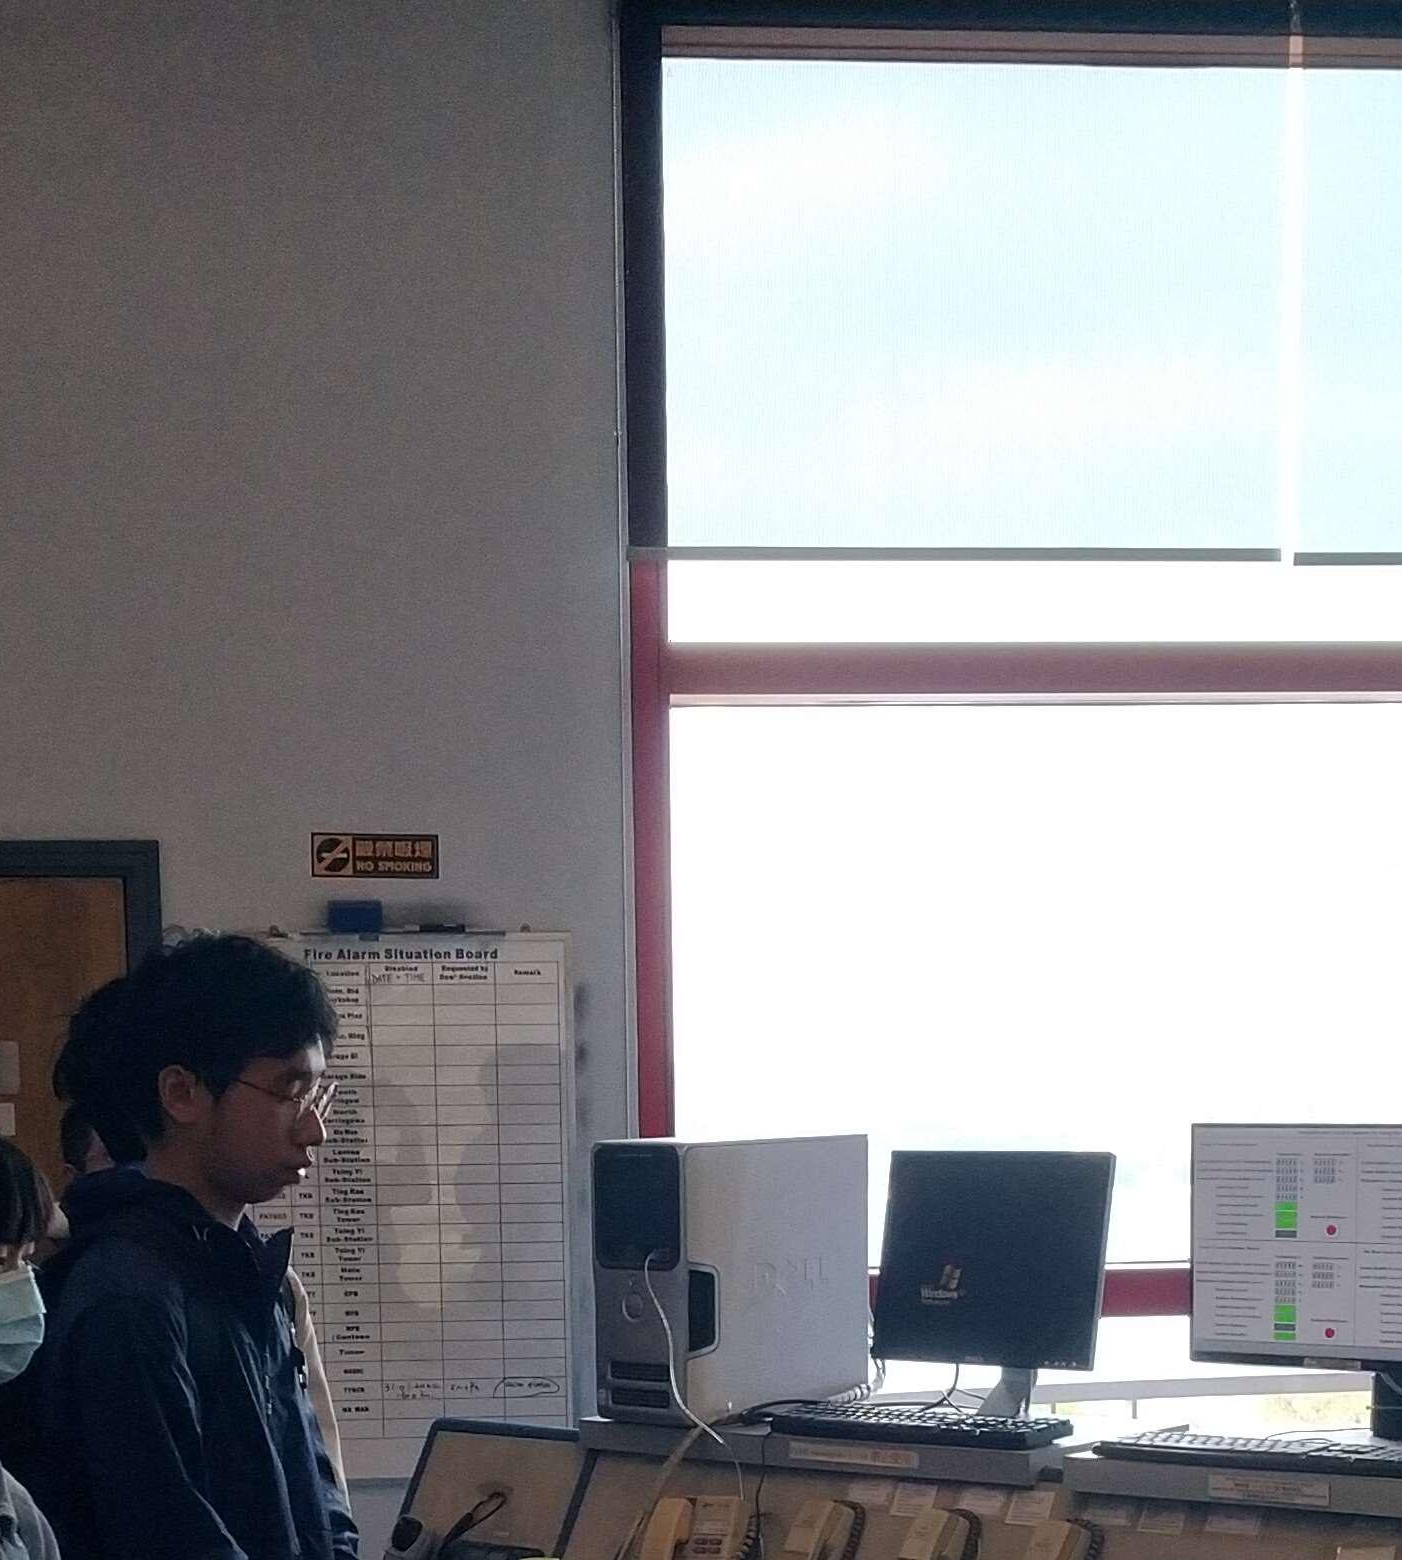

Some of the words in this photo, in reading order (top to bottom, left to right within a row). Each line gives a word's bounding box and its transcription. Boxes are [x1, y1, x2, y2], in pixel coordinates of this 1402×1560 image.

[356, 861, 374, 872] NO
[378, 861, 432, 873] SMOKING
[304, 948, 333, 960] Fire
[336, 948, 381, 960] Alarm
[384, 948, 451, 960] Situation
[455, 948, 498, 960] Board
